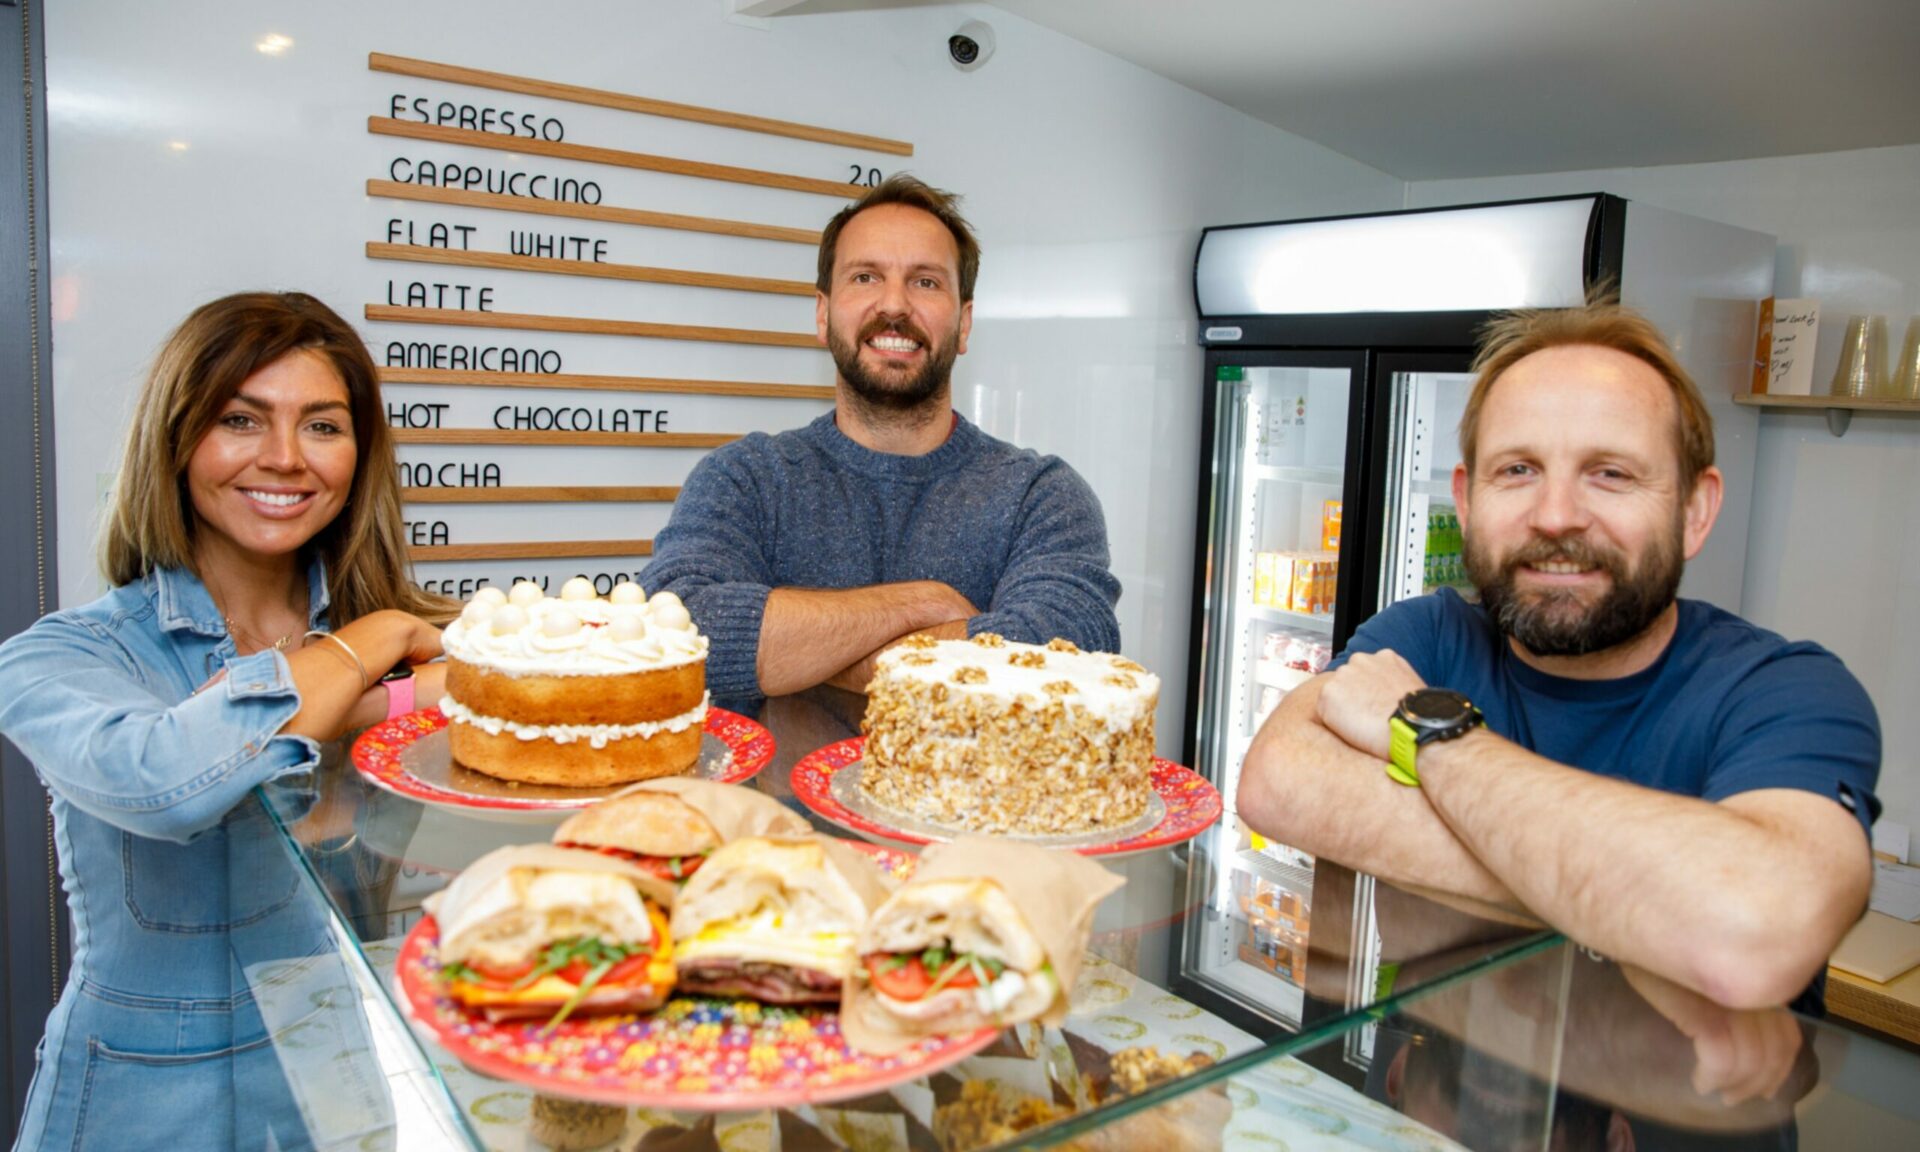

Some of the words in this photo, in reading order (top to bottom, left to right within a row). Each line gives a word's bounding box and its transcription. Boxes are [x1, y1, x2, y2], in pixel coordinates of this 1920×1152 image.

[391, 95, 564, 143] ESPRESSO
[390, 157, 602, 205] CAPPUCCINO
[388, 218, 477, 250] FLAT
[510, 230, 608, 263] WHITE
[388, 280, 494, 312] LATTE
[387, 341, 562, 374] AMERICANO
[388, 403, 450, 429] HOT
[493, 405, 669, 433] CHOCOLATE
